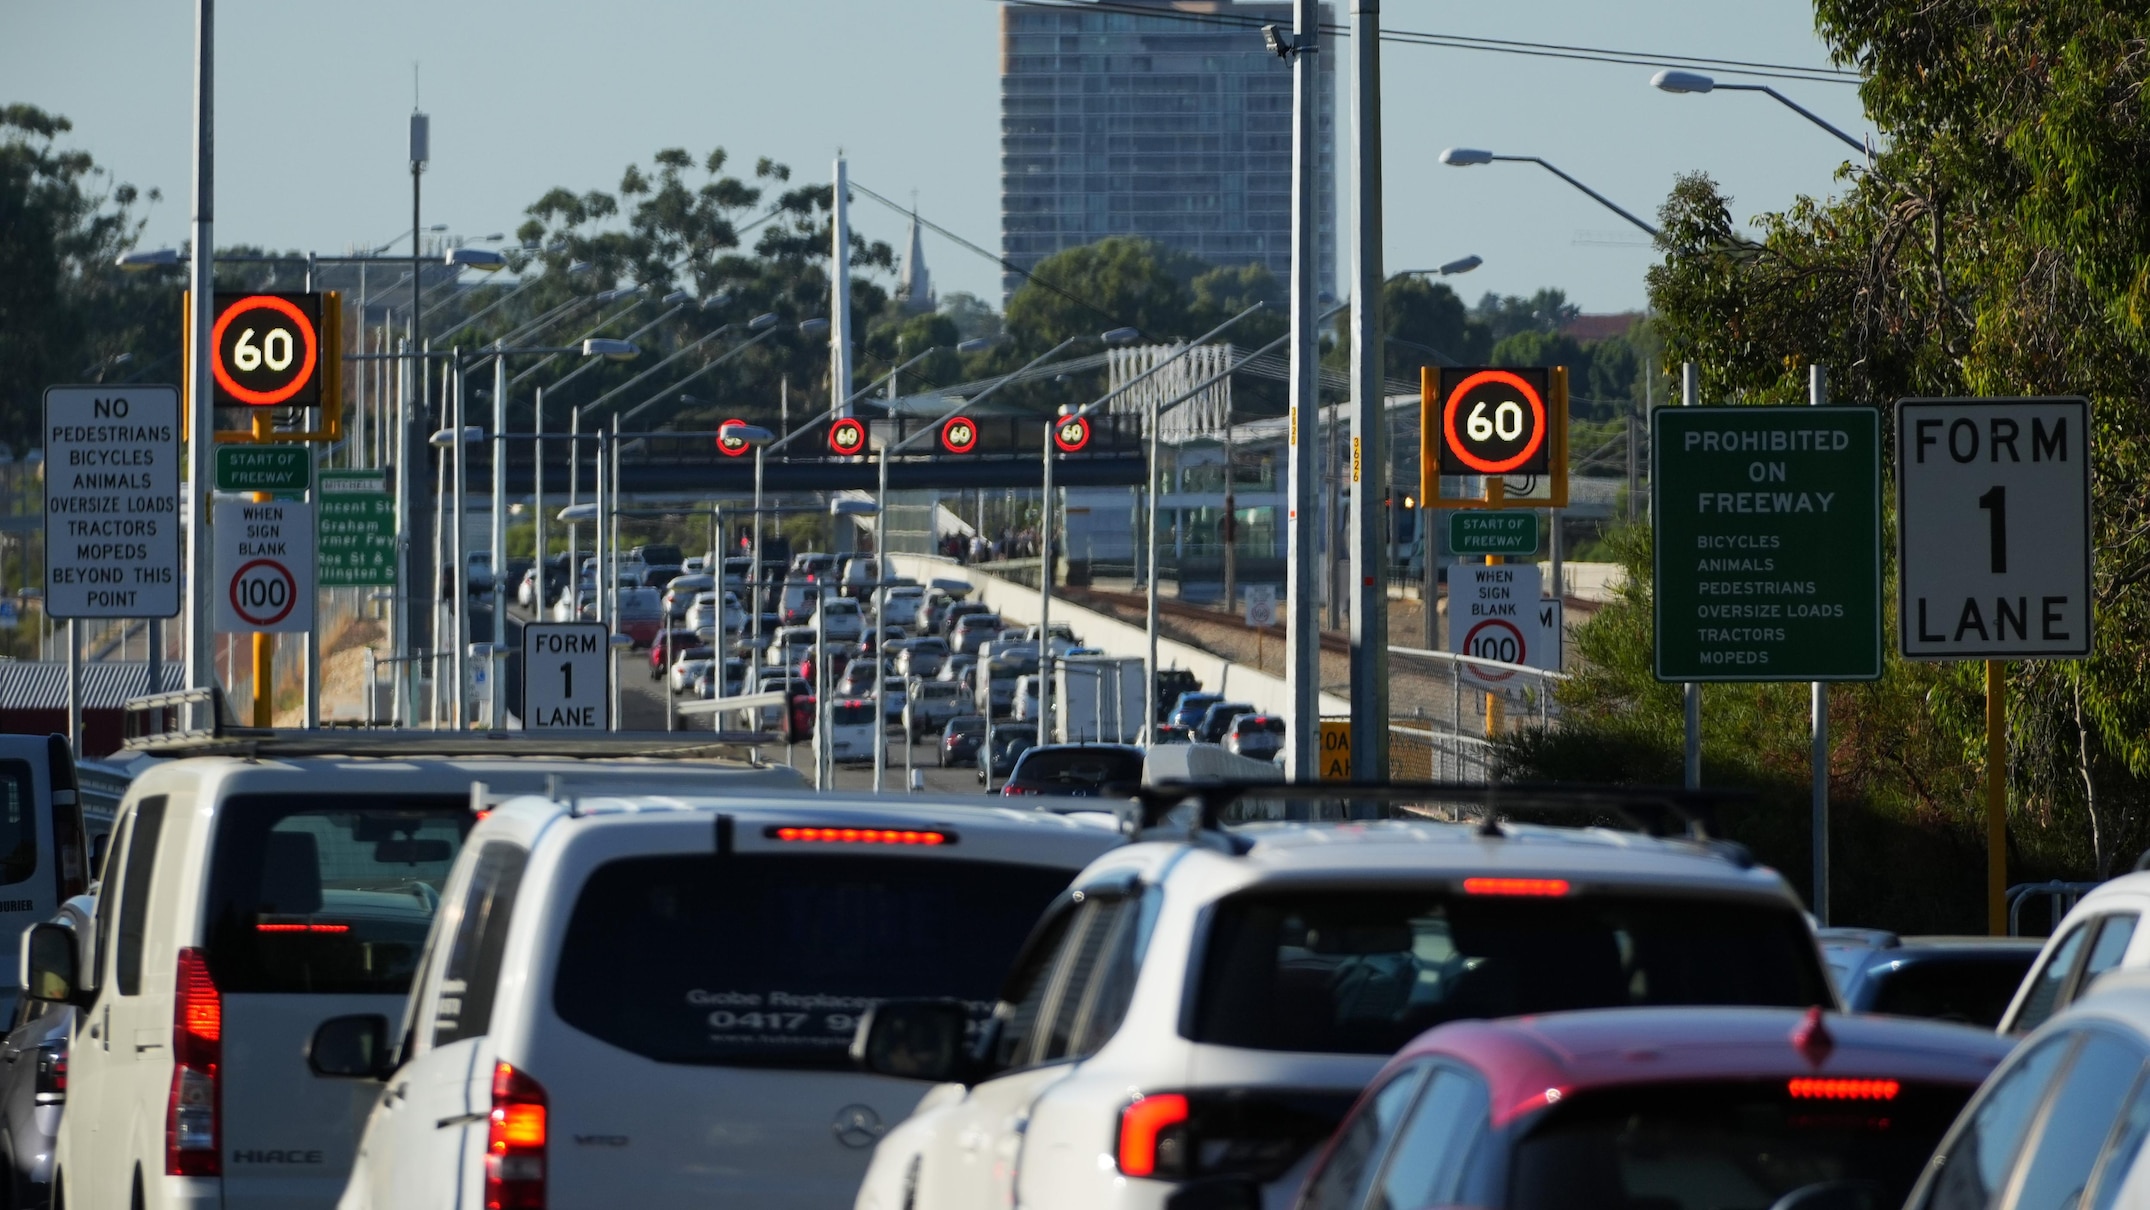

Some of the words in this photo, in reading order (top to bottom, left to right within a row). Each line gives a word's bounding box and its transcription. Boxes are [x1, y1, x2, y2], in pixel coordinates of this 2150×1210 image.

[234, 327, 294, 372] 60
[94, 398, 129, 419] NO
[1466, 401, 1523, 442] 60
[52, 425, 171, 443] PEDESTRIANS
[837, 428, 858, 445] 60
[950, 426, 971, 444] 60
[1061, 424, 1083, 442] 60
[1684, 430, 1849, 452] PROHIBITED
[1916, 416, 2068, 464] FORM
[69, 449, 154, 466] BICYCLES
[230, 453, 273, 466] START
[277, 453, 295, 465] OF
[231, 471, 293, 483] FREEWAY
[1748, 461, 1786, 482] ON
[73, 473, 151, 489] ANIMALS
[50, 496, 118, 513] OVERSIZE
[128, 496, 174, 513] LOADS
[320, 501, 366, 512] incent
[1698, 492, 1835, 513] FREEWAY
[243, 507, 283, 521] WHEN
[67, 520, 157, 537] TRACTORS
[247, 525, 280, 538] SIGN
[321, 519, 379, 532] Graham
[1463, 518, 1504, 530] START
[1507, 519, 1525, 530] OF
[1979, 485, 2007, 574] 1
[239, 542, 286, 556] BLANK
[319, 536, 358, 546] rmer
[1464, 535, 1522, 547] FREEWAY
[1697, 535, 1781, 549] BICYCLES
[77, 543, 147, 560] MOPEDS
[350, 552, 366, 565] St
[374, 551, 383, 565] &
[1697, 558, 1774, 572] ANIMALS
[52, 567, 124, 584] BEYOND
[134, 567, 172, 583] THIS
[320, 567, 378, 581] llington
[1475, 570, 1513, 583] WHEN
[239, 579, 286, 608] 100
[1479, 586, 1510, 600] SIGN
[1698, 581, 1816, 595] PEDESTRIANS
[87, 591, 137, 607] POINT
[1471, 603, 1517, 616] BLANK
[1697, 604, 1781, 618] OVERSIZE
[1787, 604, 1844, 618] LOADS
[1918, 595, 2070, 643] LANE
[1697, 627, 1786, 642] TRACTORS
[536, 634, 596, 654] FORM
[1473, 637, 1516, 664] 100
[1699, 650, 1769, 665] MOPEDS
[560, 661, 572, 699] 1
[536, 707, 595, 727] LANE
[0, 899, 34, 912] URIER
[708, 1010, 808, 1030] 0417
[233, 1149, 323, 1164] HIACE
